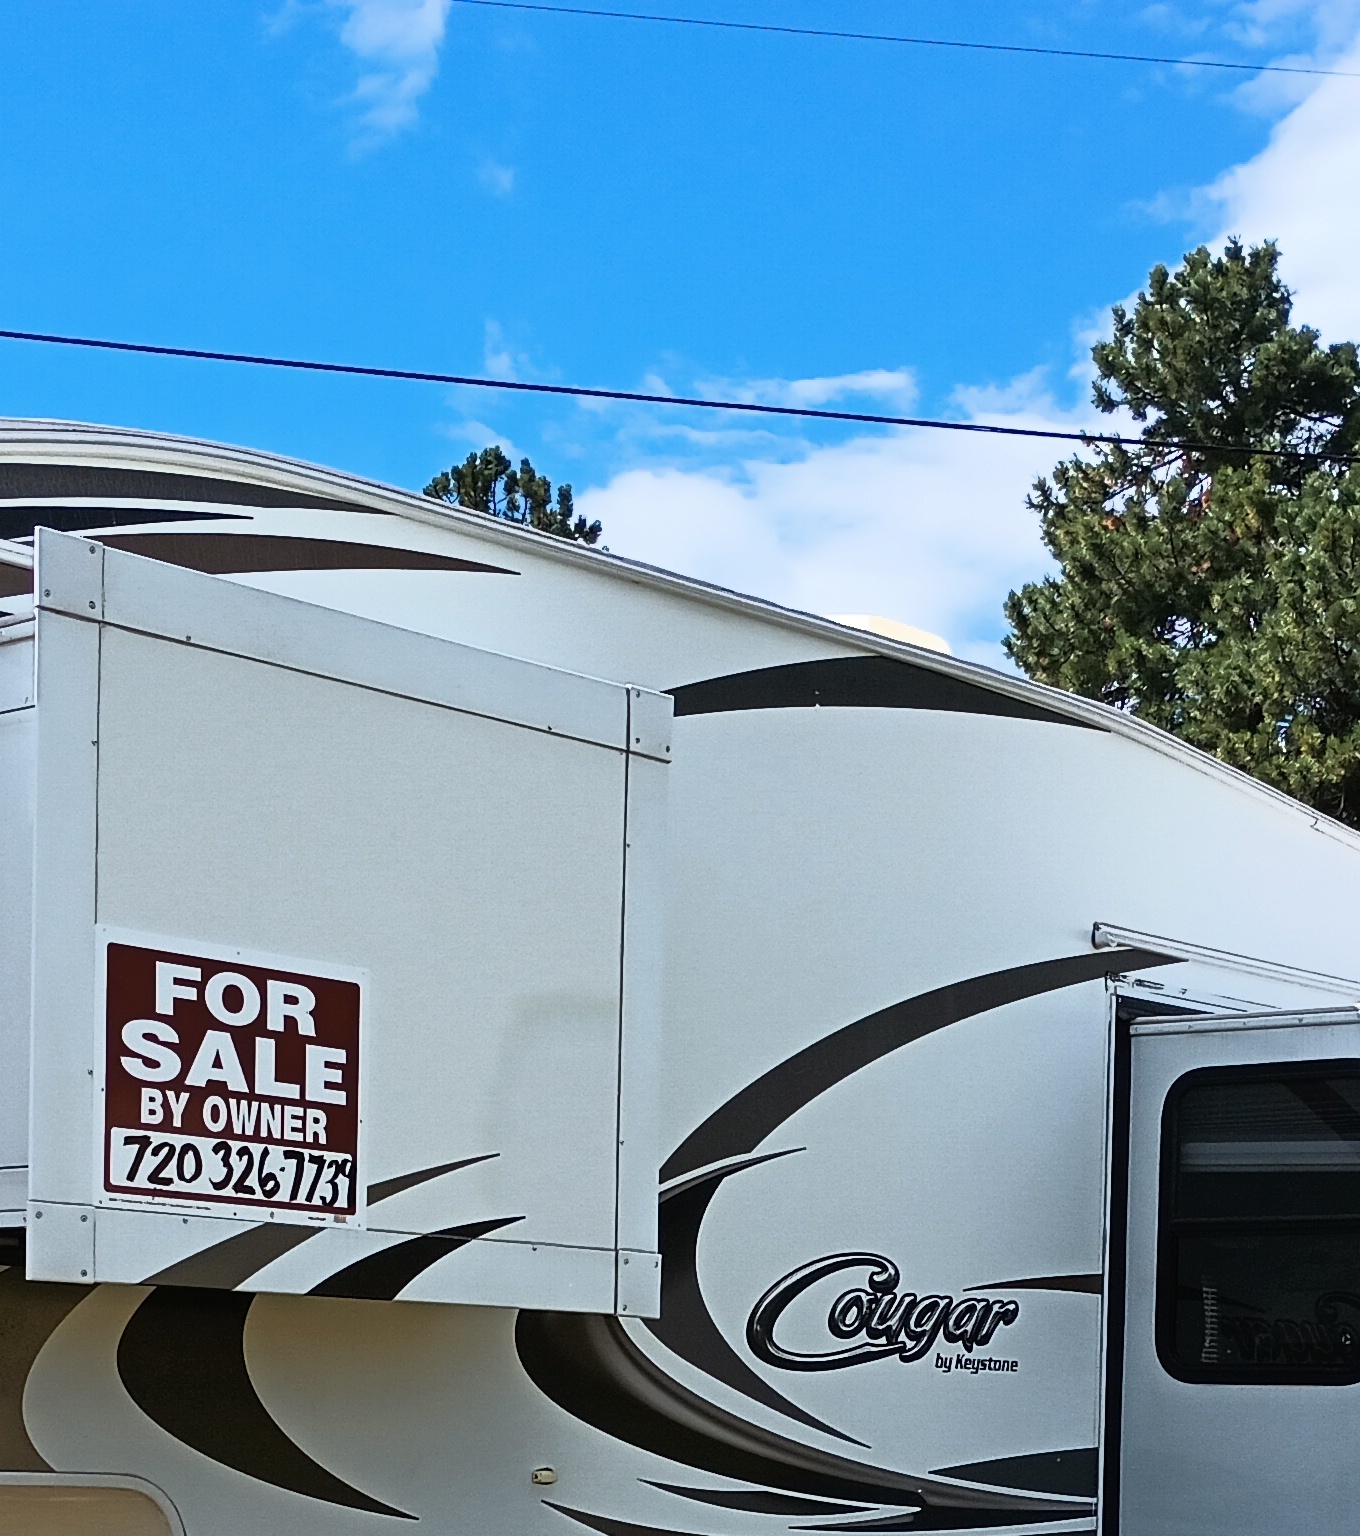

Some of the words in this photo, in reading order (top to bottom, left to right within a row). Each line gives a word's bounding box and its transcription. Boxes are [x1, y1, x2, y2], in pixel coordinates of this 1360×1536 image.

[155, 961, 317, 1037] FOR
[120, 1019, 347, 1105] SALE
[140, 1087, 190, 1128] BY
[202, 1095, 327, 1145] OWNER
[123, 1135, 203, 1186] 720
[746, 1251, 1019, 1372] Cougar
[934, 1353, 952, 1373] by
[955, 1353, 1019, 1374] Keystone
